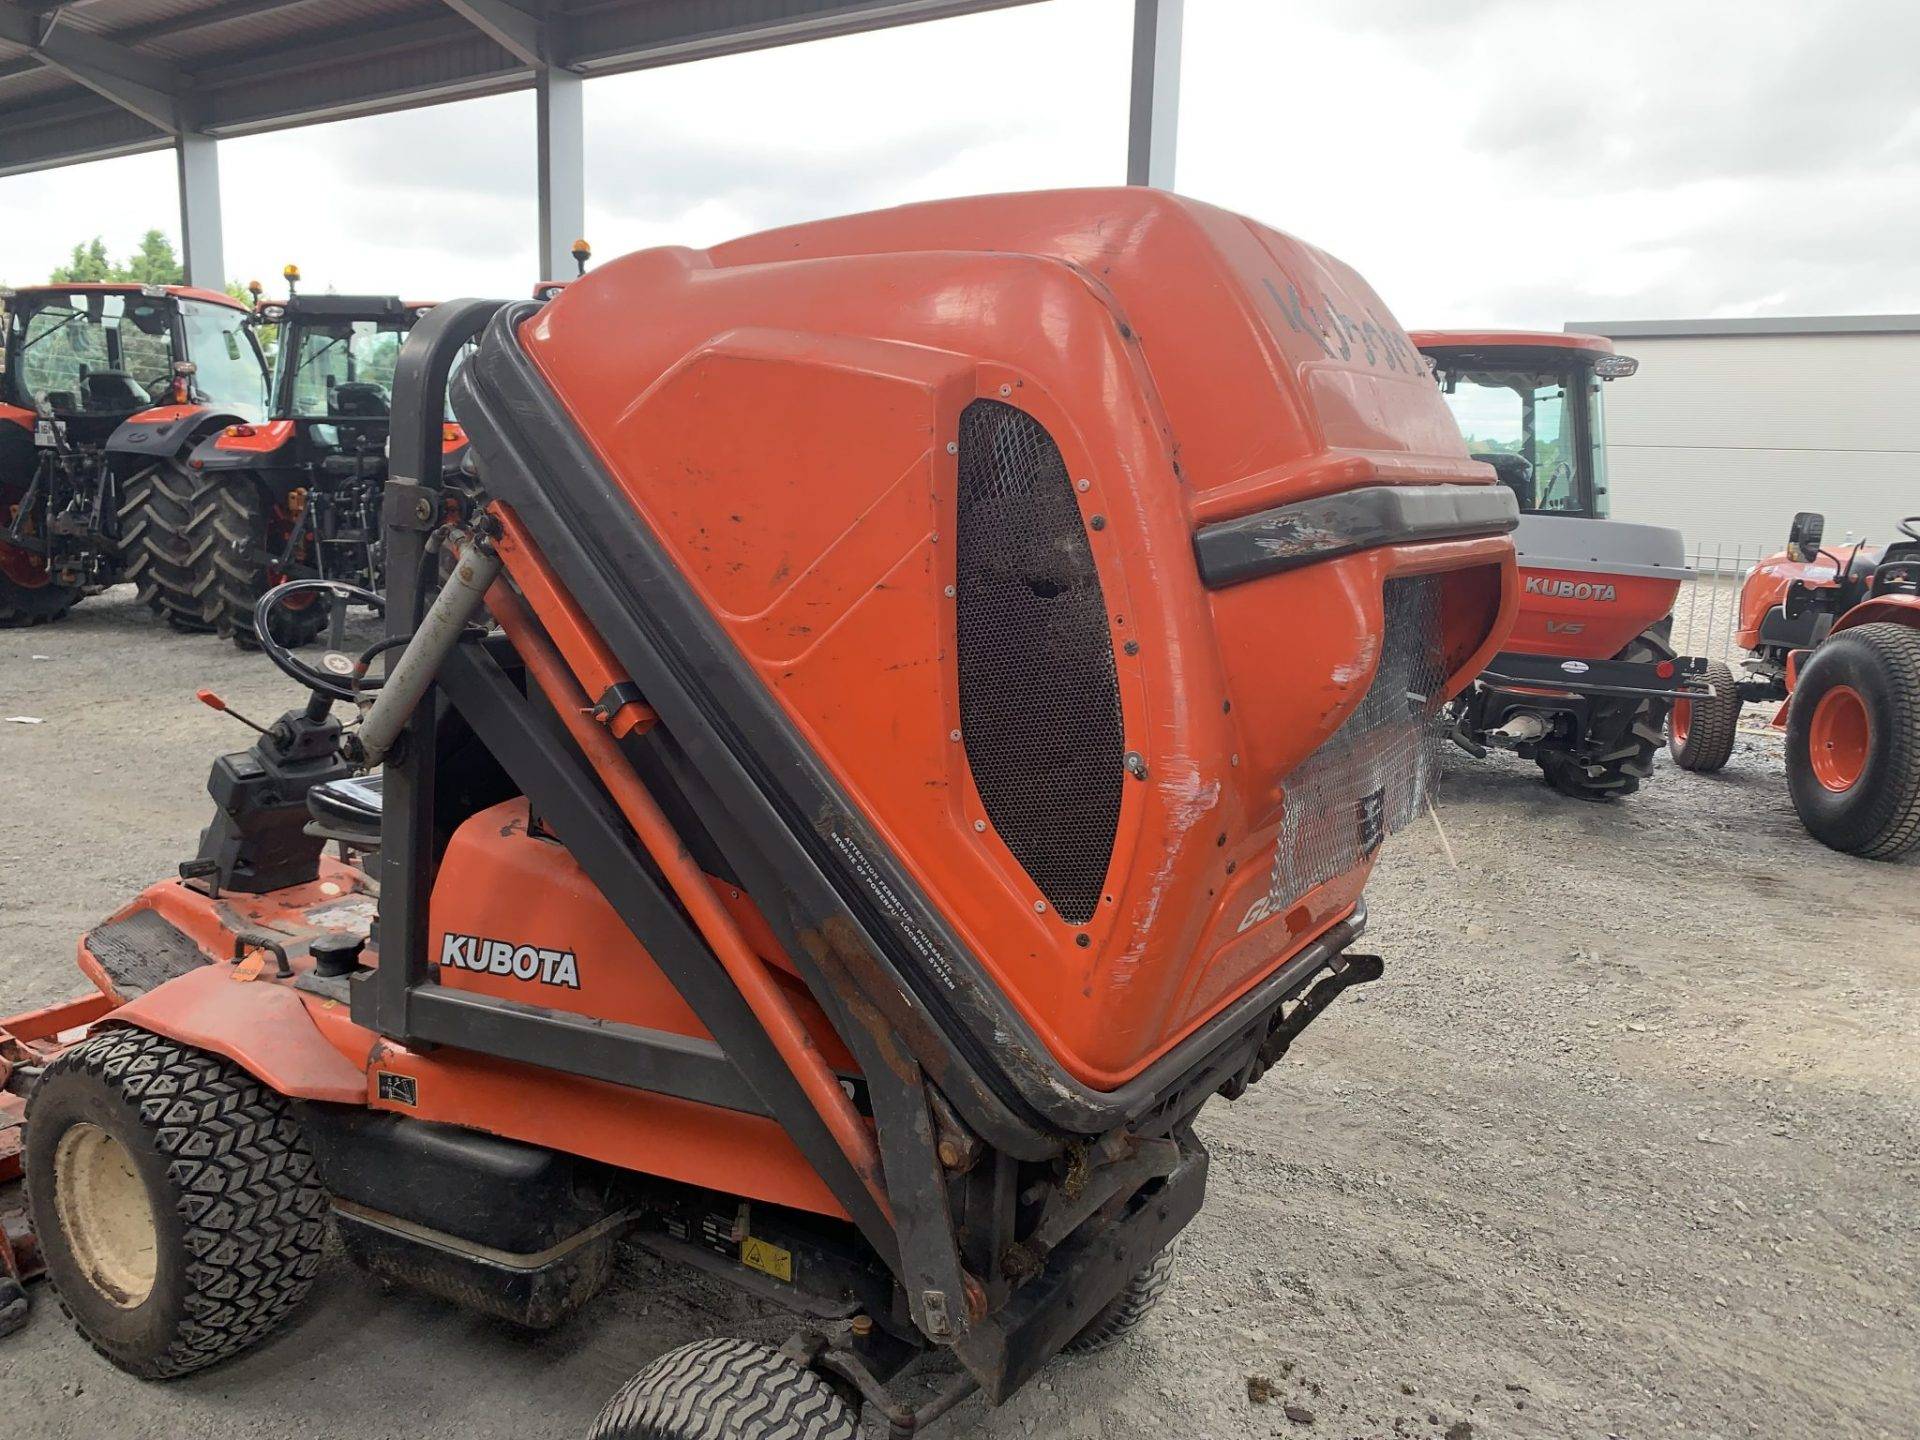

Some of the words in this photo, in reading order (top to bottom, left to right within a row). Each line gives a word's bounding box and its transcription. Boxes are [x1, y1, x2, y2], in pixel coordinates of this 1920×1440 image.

[1526, 576, 1616, 601] KUBOTA
[831, 832, 857, 864] BEWARE
[857, 865, 867, 875] OF
[900, 920, 929, 956] LOCKING
[929, 957, 956, 990] SYSTEM
[844, 837, 879, 880] ATTENTION
[879, 880, 915, 928] FERMETUR
[441, 933, 580, 989] KUBOTA
